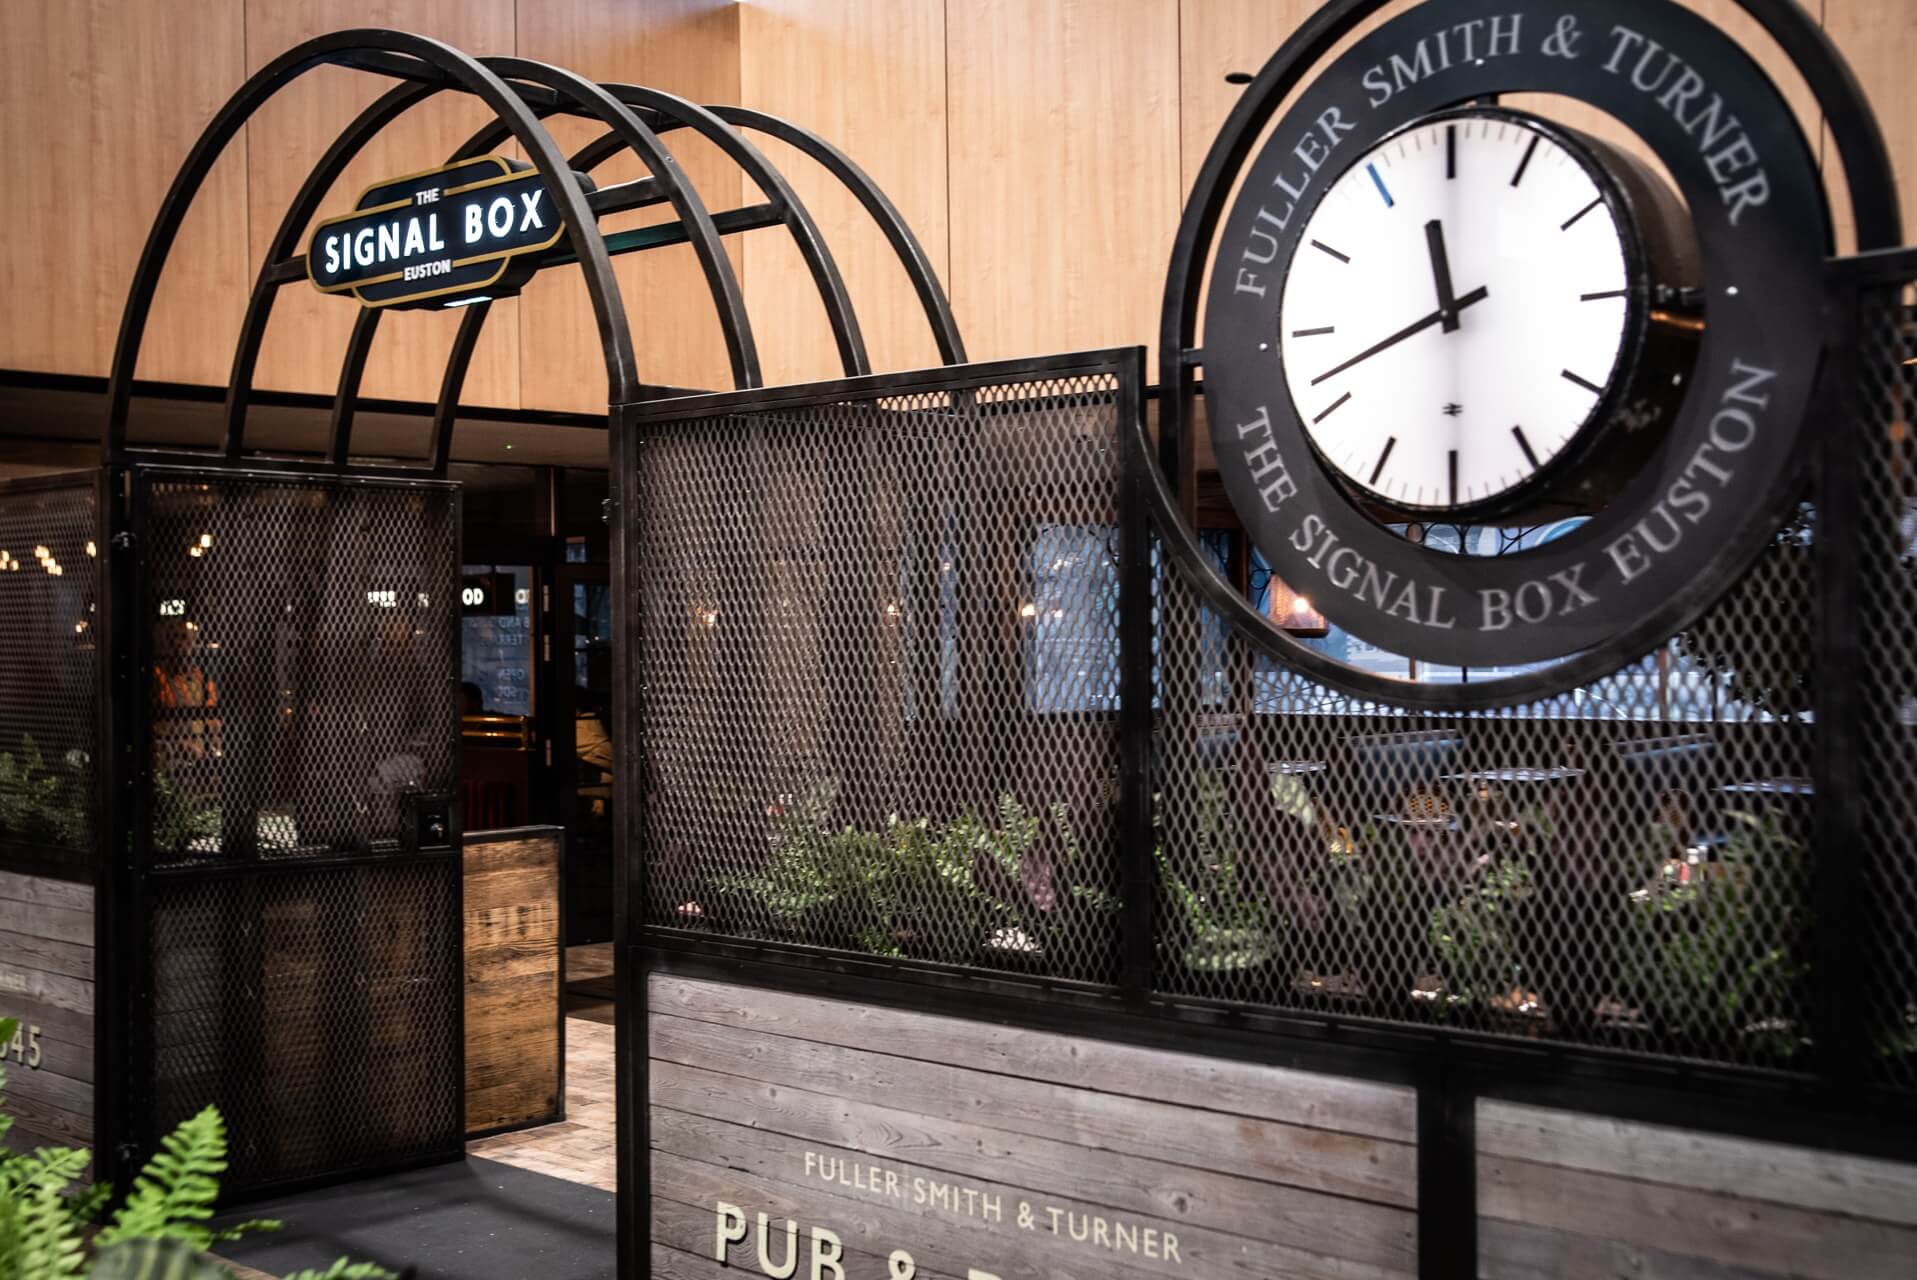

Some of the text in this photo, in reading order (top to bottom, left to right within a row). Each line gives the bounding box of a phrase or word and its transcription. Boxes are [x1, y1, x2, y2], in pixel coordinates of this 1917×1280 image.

[415, 188, 440, 206] THE
[1234, 13, 1771, 298] FULLER SMITH & TURNER
[325, 190, 544, 274] SIGNAL BOX
[403, 259, 451, 281] EUSTON
[1236, 358, 1778, 632] THE SIGNAL BOX EUSTON
[716, 1201, 847, 1280] PUB
[804, 1151, 1182, 1264] FULLER SMITH & TURNER
